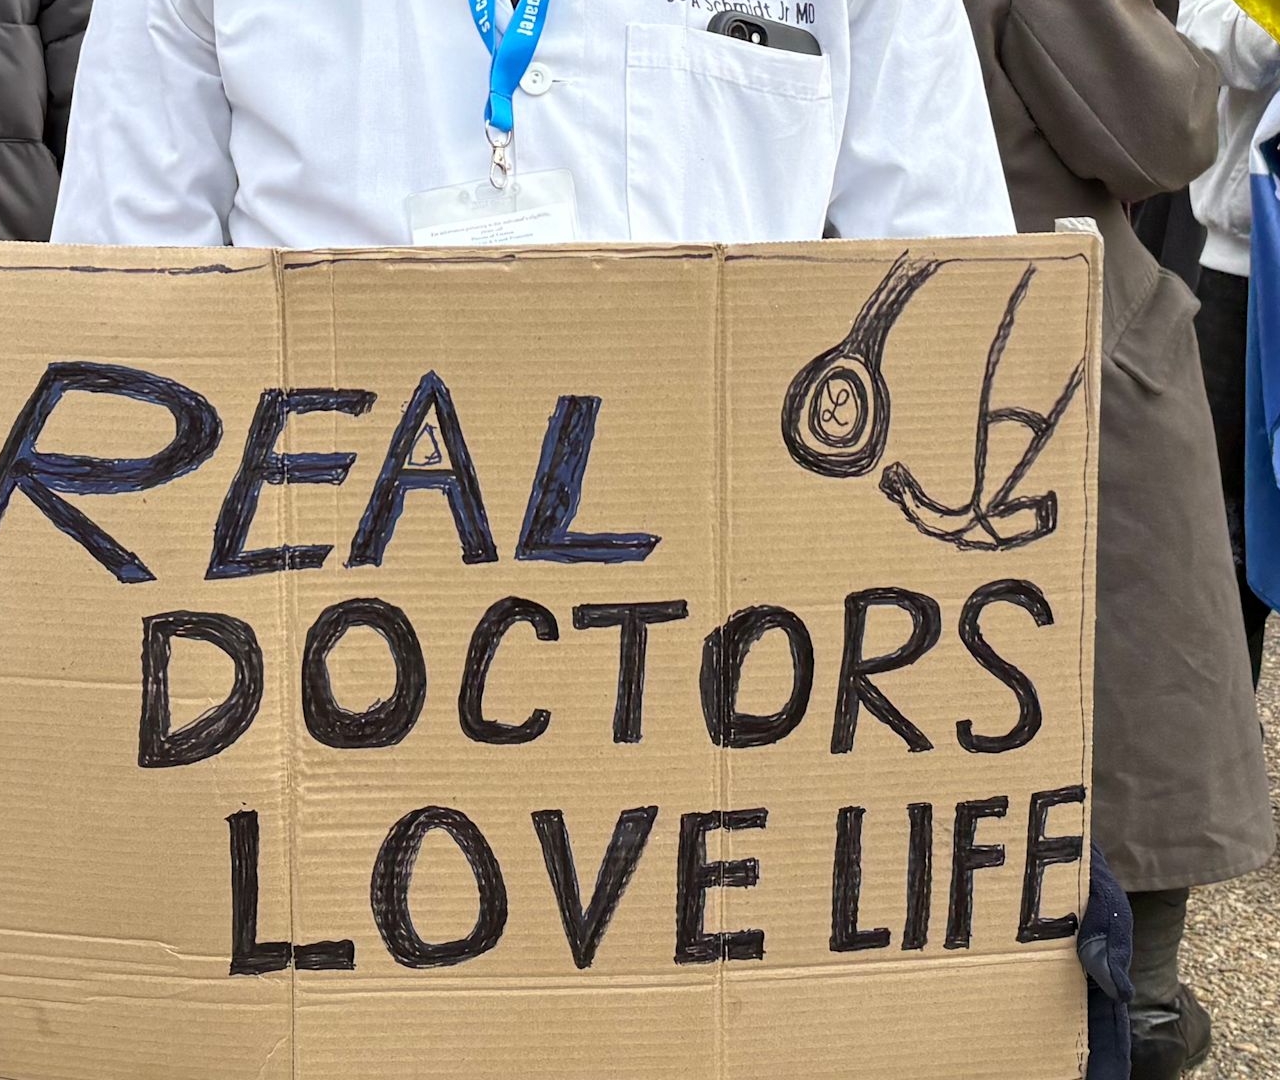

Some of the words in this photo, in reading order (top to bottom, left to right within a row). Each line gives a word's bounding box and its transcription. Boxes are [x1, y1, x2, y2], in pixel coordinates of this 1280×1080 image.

[138, 578, 1054, 768] DOCTORS
[227, 804, 768, 976] LOVE
[829, 784, 1087, 954] LIFE
